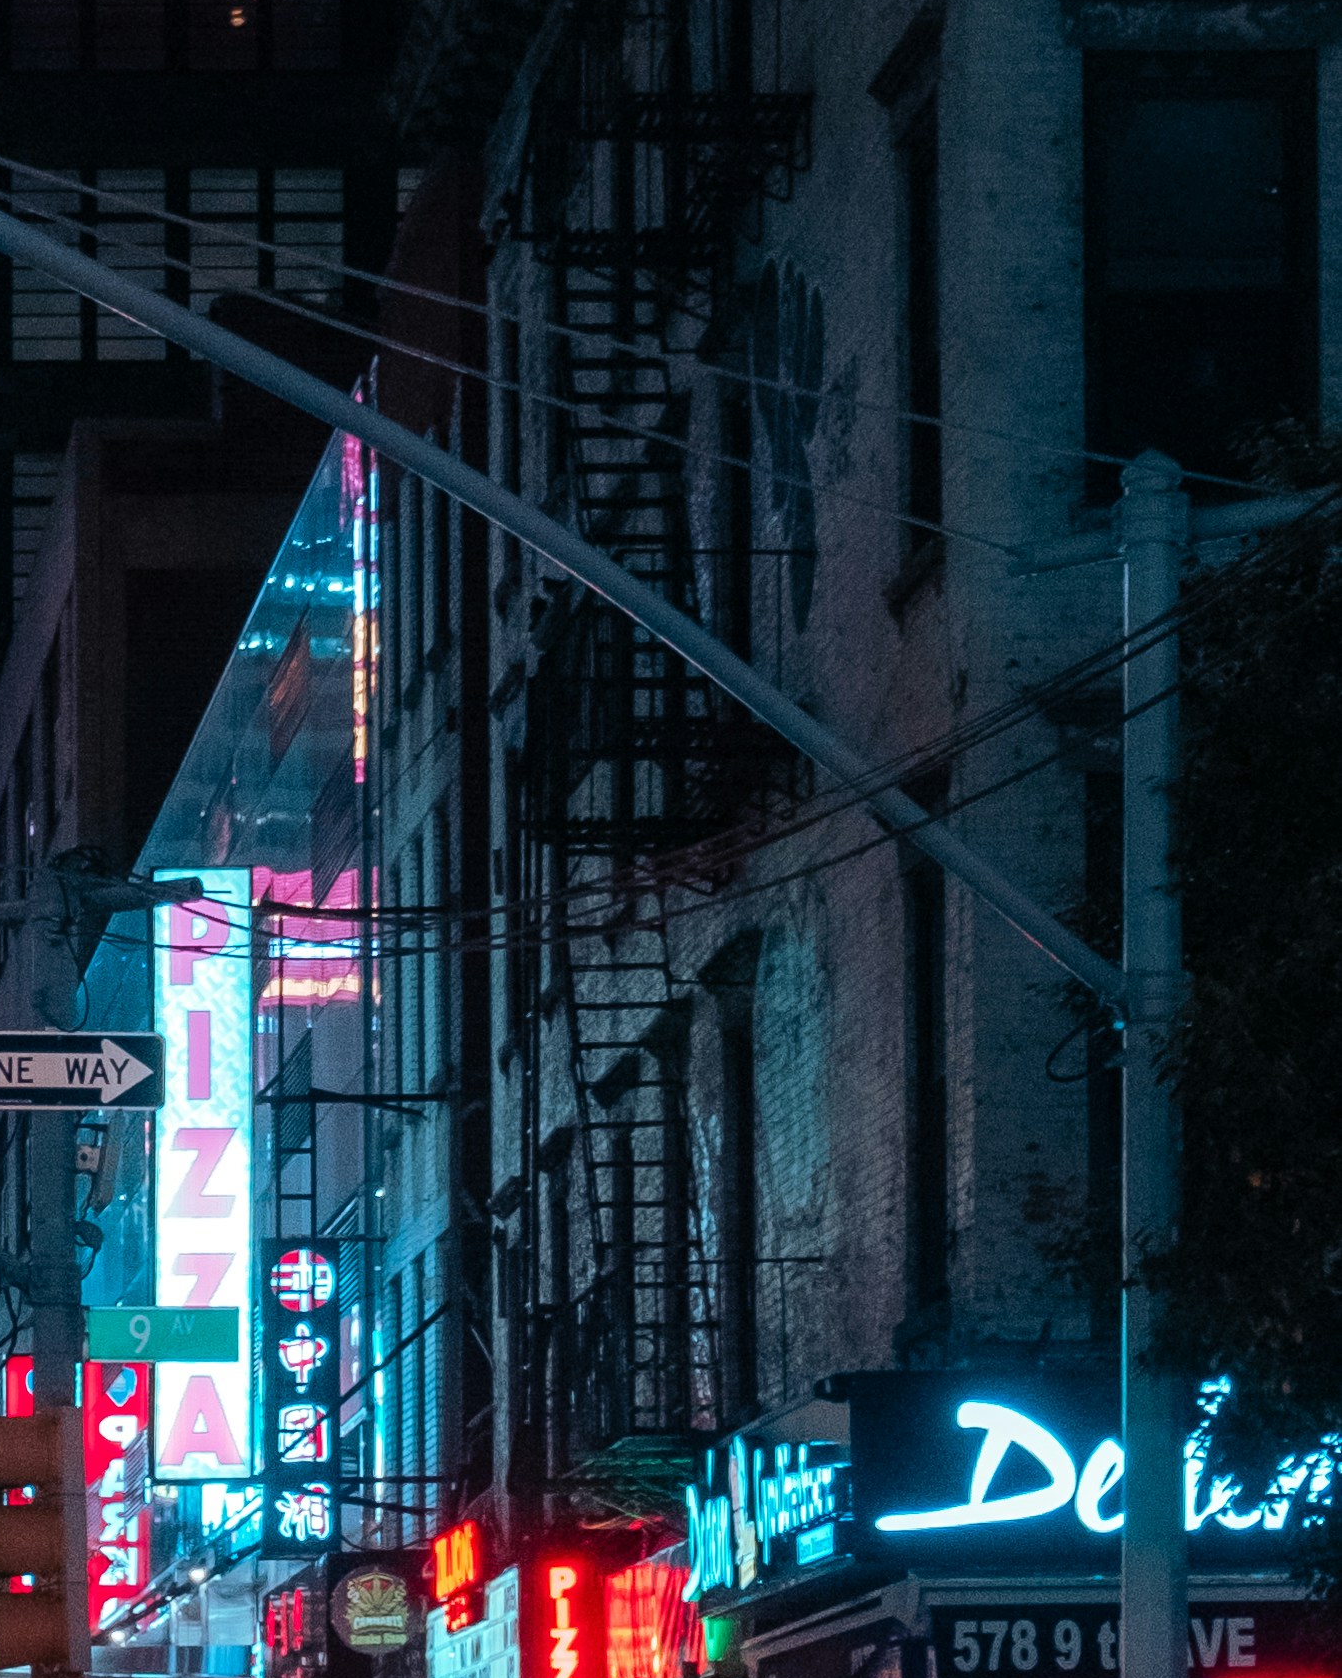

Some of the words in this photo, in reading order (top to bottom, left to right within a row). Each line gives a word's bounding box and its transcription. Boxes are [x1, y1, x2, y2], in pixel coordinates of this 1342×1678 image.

[65, 1057, 130, 1085] WAY
[158, 899, 246, 1467] PIZZA
[128, 1314, 151, 1354] 9
[170, 1314, 196, 1336] AV
[953, 1620, 1038, 1672] 578
[1054, 1619, 1082, 1671] 9
[1097, 1619, 1122, 1671] t
